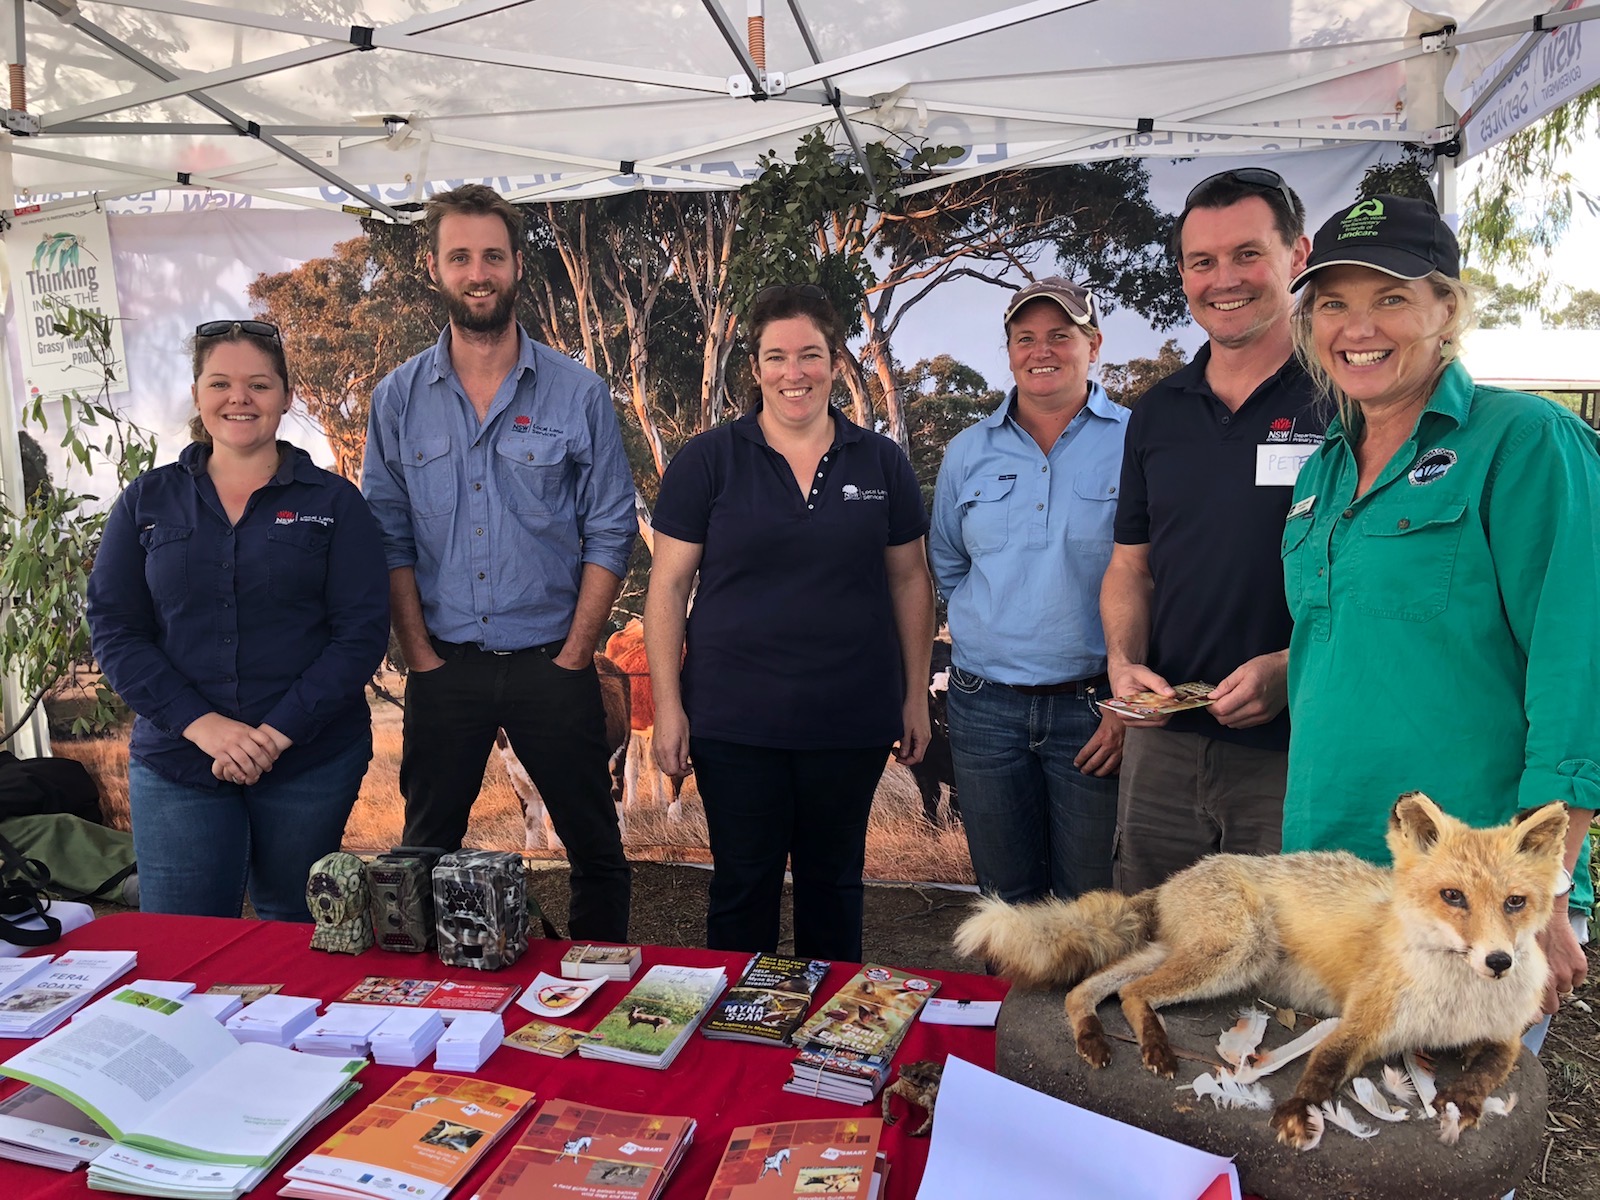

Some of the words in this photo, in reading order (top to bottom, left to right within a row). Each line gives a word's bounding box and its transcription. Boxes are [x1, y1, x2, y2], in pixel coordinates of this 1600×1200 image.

[1337, 231, 1379, 240] Landcare
[26, 263, 99, 296] Thinking
[74, 290, 99, 304] THE
[37, 340, 65, 355] Grassy
[1267, 431, 1290, 439] NSW
[49, 972, 90, 981] FERAL
[37, 982, 83, 990] GOATS
[724, 1004, 764, 1014] MYNA
[725, 1012, 763, 1021] SCAN
[841, 1023, 885, 1039] Canid
[818, 1030, 875, 1051] Ejector
[843, 1031, 880, 1046] Pest
